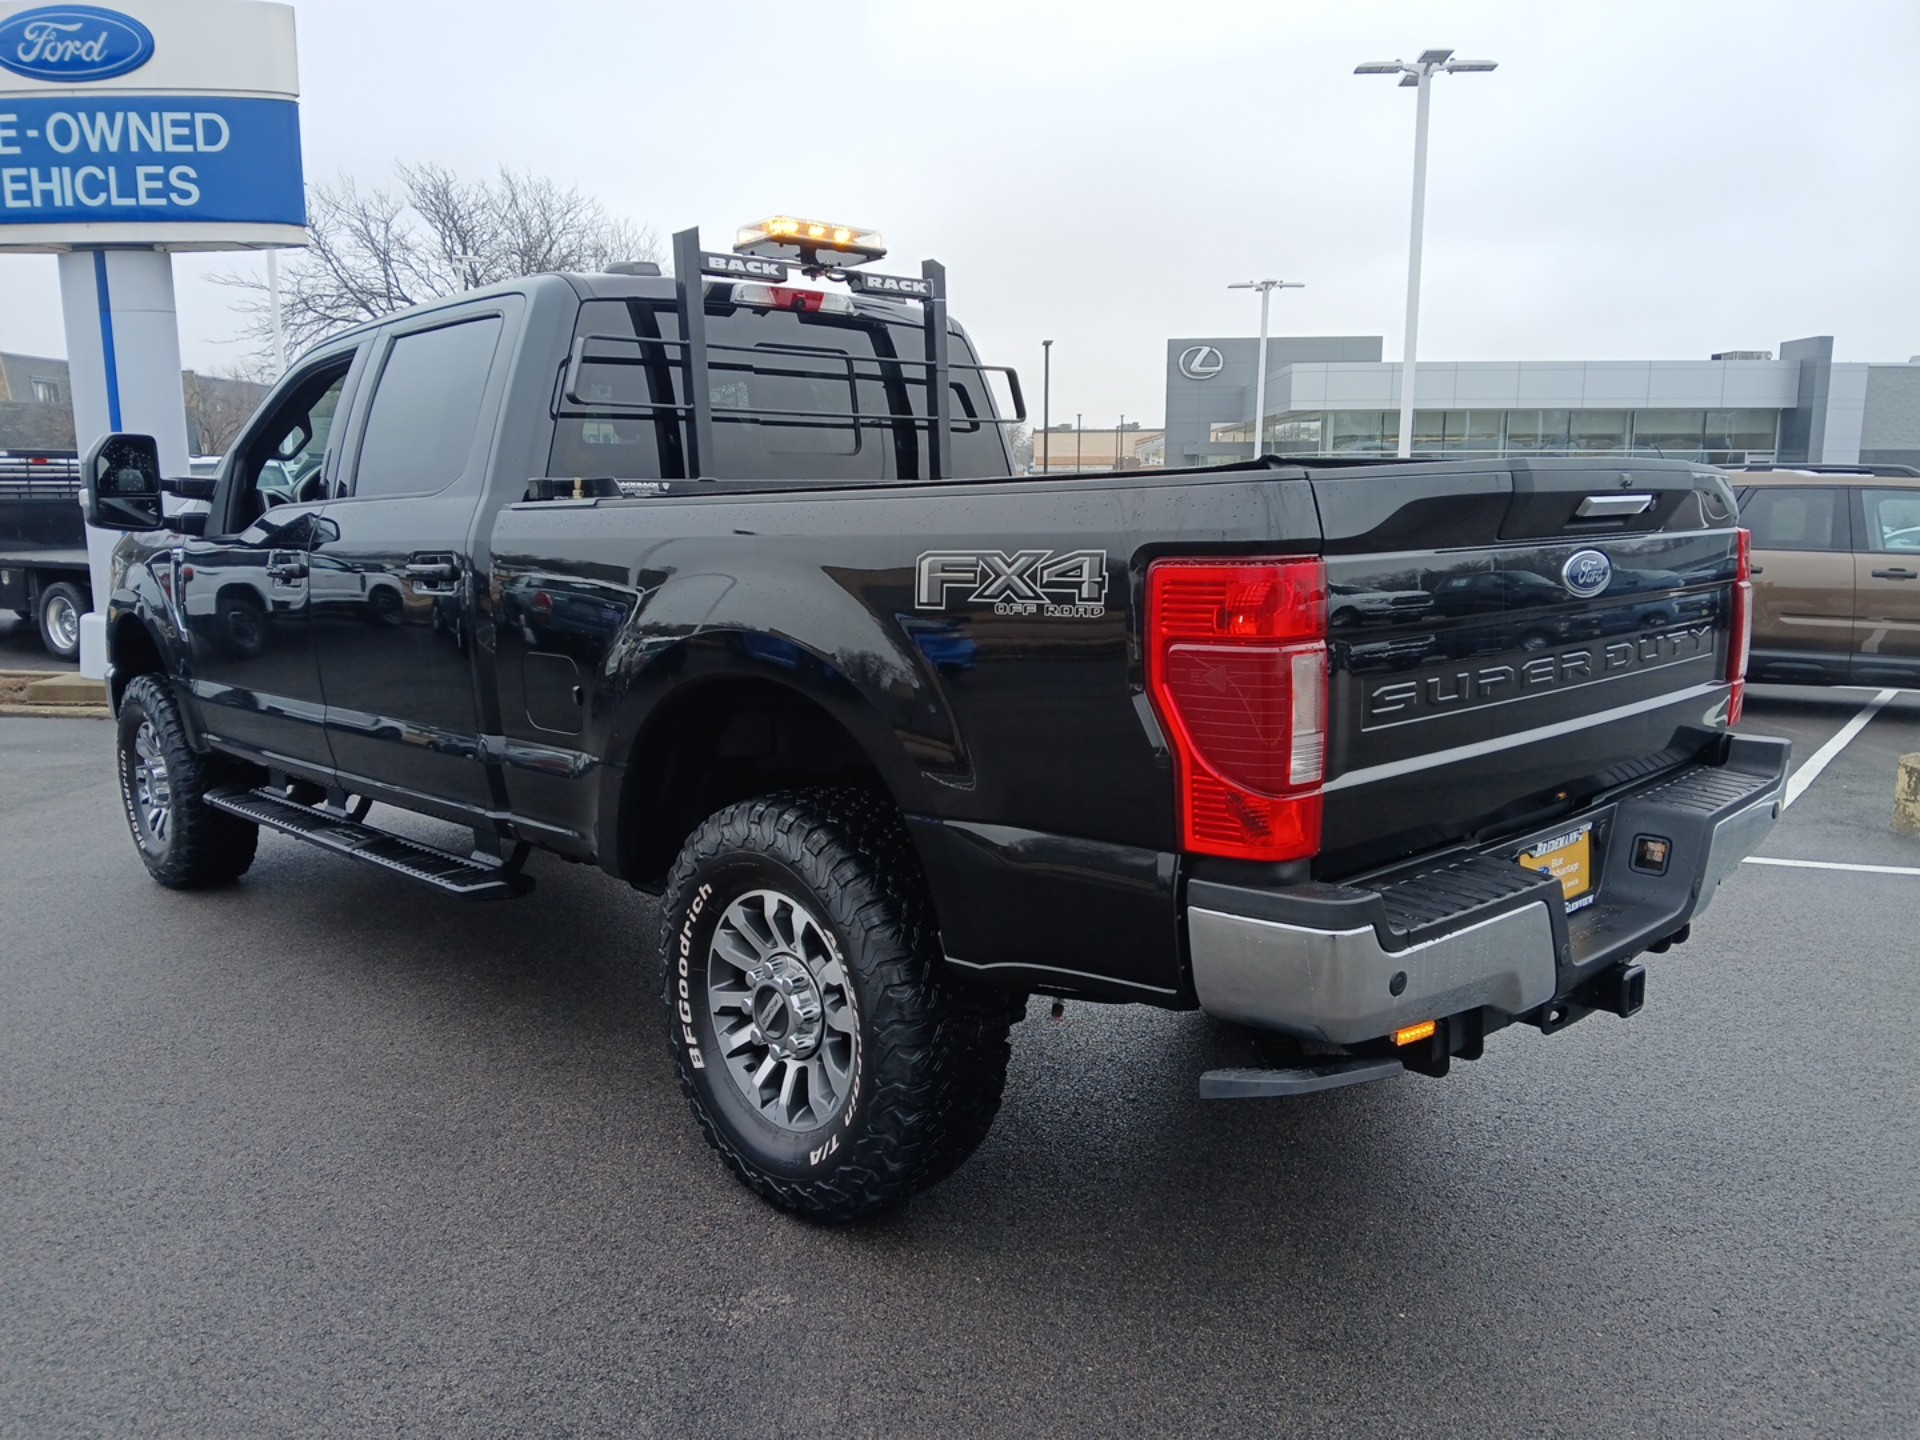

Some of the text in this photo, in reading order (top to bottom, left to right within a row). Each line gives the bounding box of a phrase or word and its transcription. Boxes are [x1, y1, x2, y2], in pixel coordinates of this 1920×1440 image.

[17, 21, 108, 62] Ford
[2, 165, 201, 208] EHICLES
[708, 256, 928, 293] BACK RACK
[915, 550, 1108, 609] FX4
[1578, 559, 1605, 585] Ford
[994, 603, 1105, 618] OFF ROAD
[1371, 625, 1711, 717] SUPER DUTY
[678, 882, 713, 1069] BFGoodrich
[810, 1134, 840, 1166] T/A
